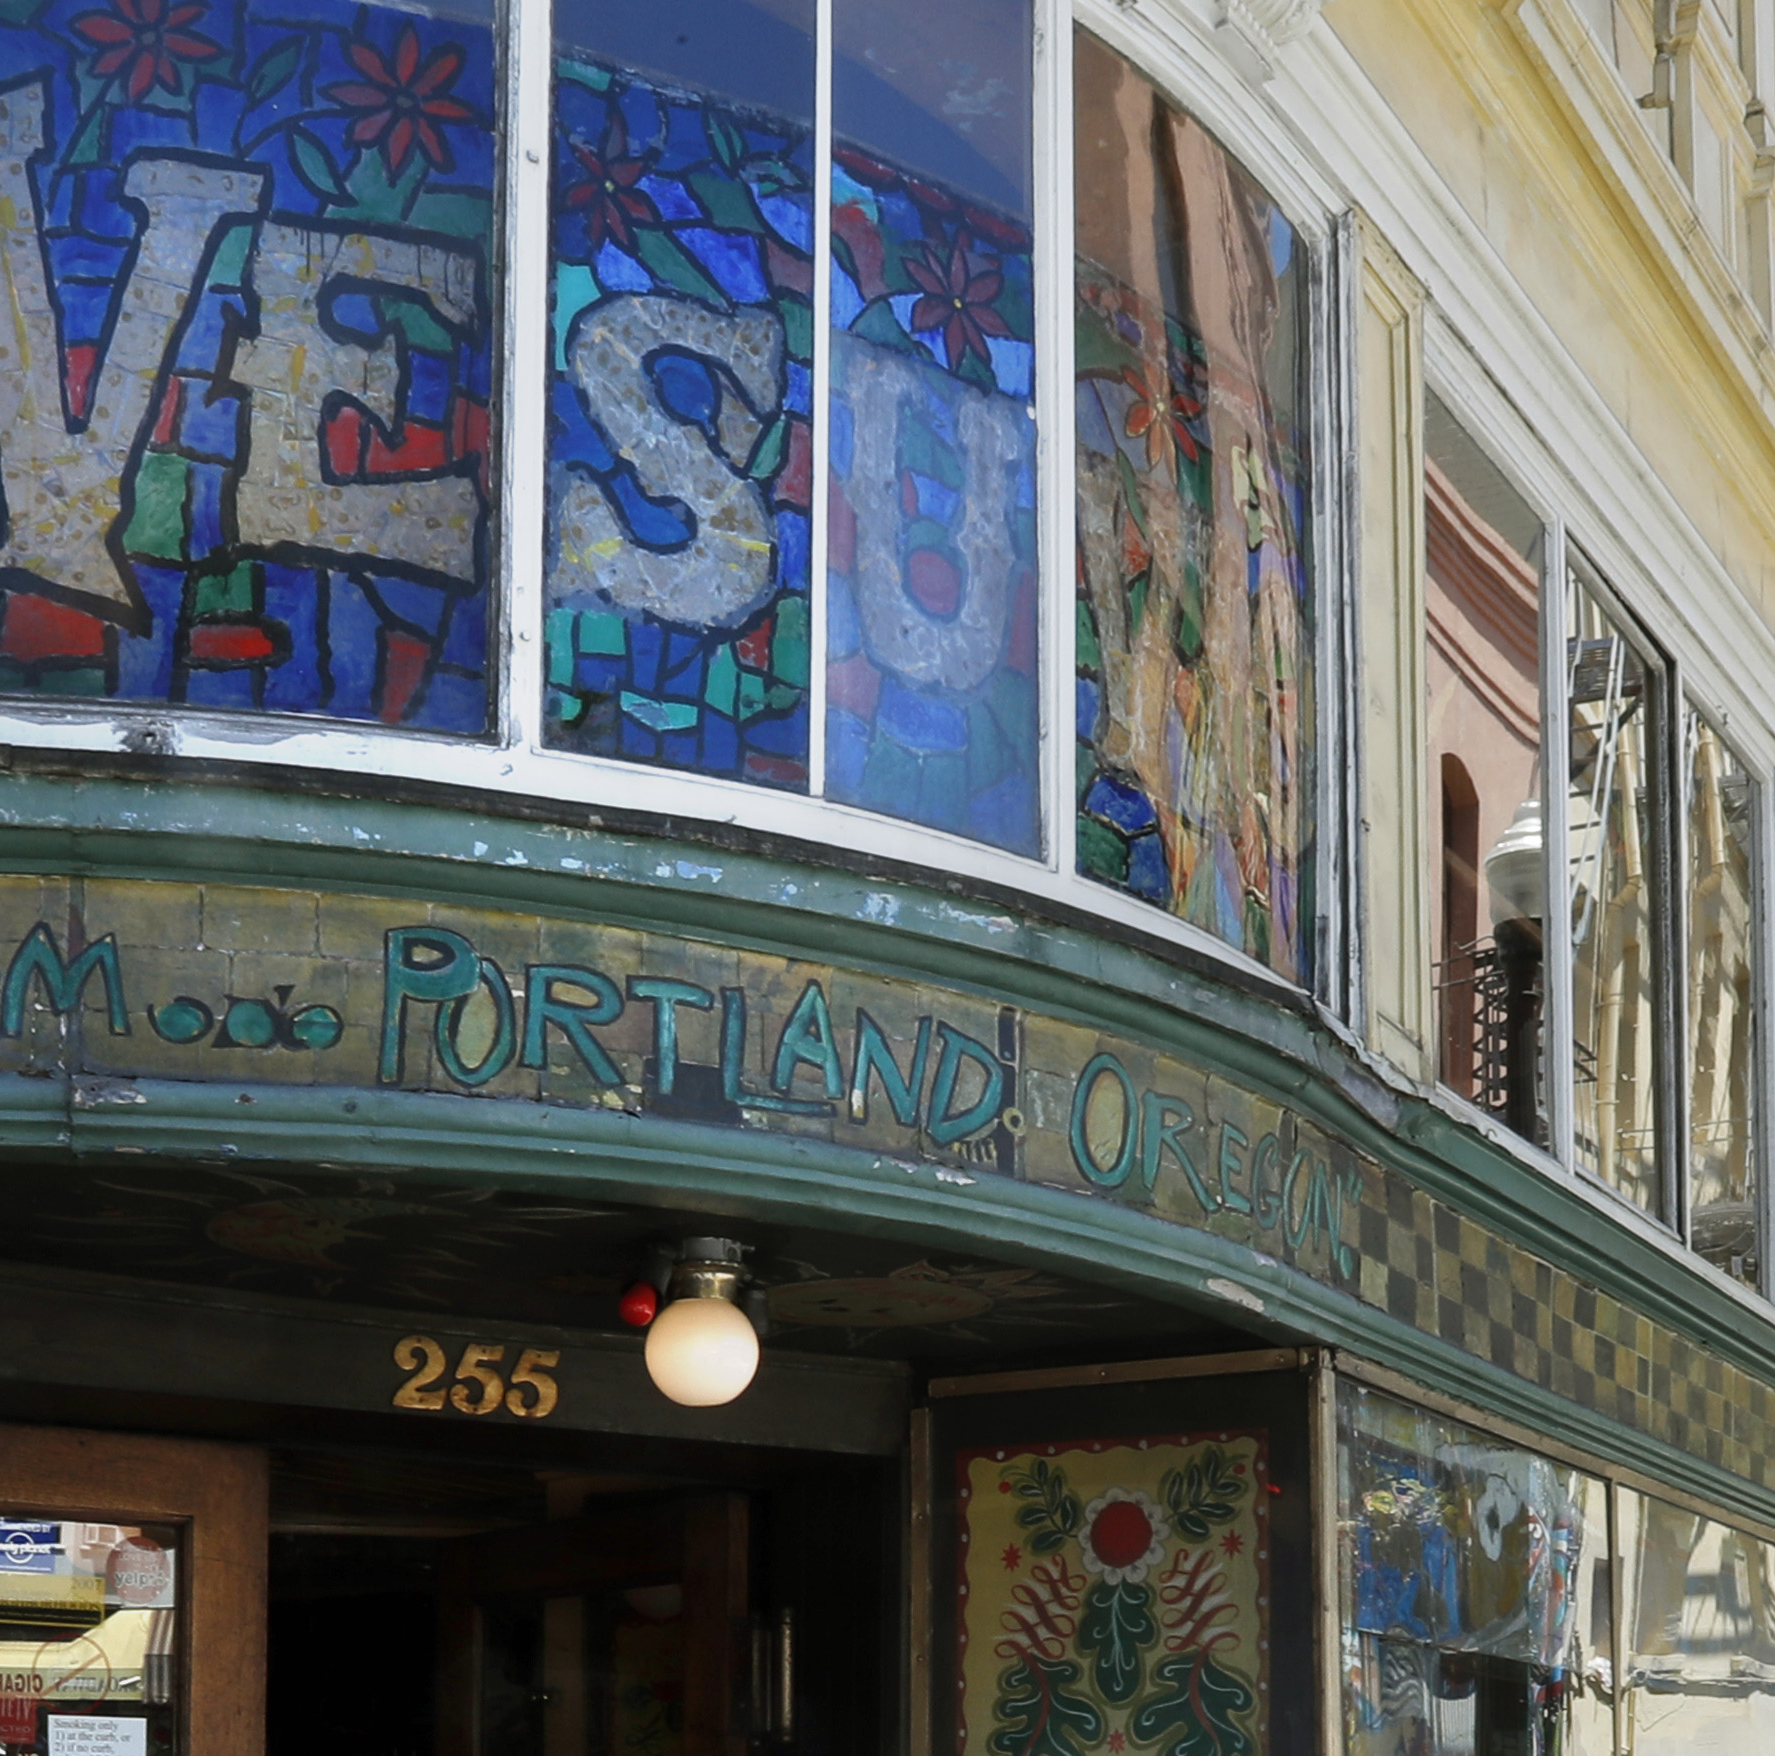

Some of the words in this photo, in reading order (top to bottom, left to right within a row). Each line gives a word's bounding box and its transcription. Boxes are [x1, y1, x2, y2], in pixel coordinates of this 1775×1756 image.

[378, 925, 1005, 1147] PORTLAND
[392, 1335, 562, 1419] 255
[114, 1571, 148, 1588] yelp
[54, 1719, 95, 1731] Smoking
[98, 1721, 119, 1732] only
[67, 1732, 77, 1741] at
[79, 1731, 93, 1741] the
[120, 1734, 131, 1742] or
[67, 1742, 75, 1752] if
[76, 1744, 89, 1753] no
